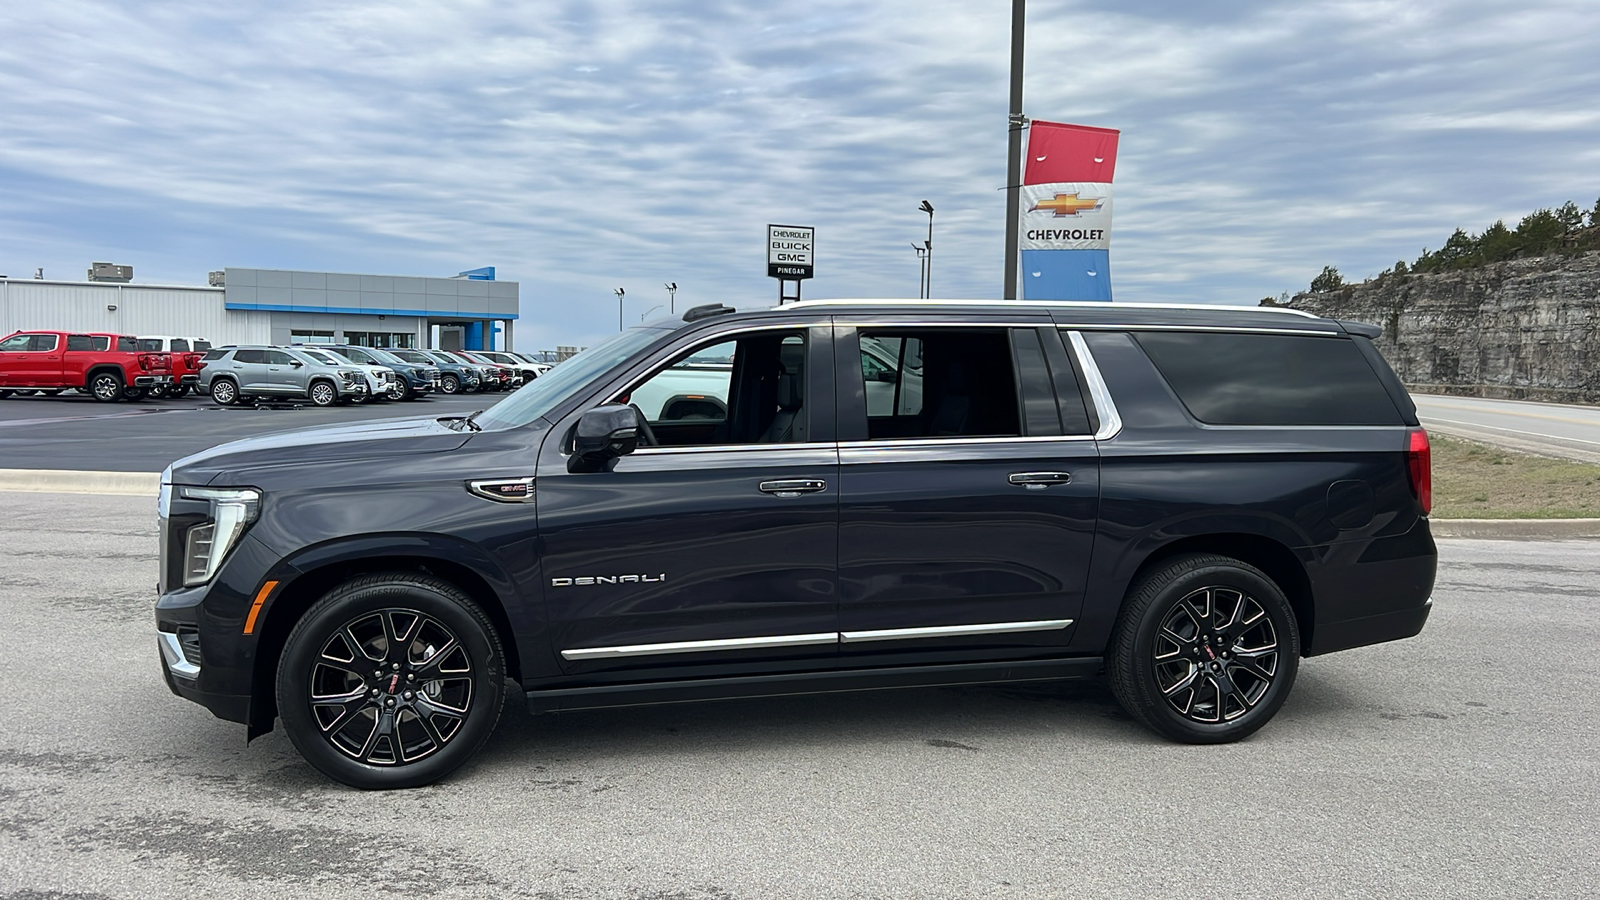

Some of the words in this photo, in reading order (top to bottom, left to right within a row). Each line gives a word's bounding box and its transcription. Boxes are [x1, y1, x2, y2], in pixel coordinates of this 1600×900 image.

[773, 230, 811, 239] CHEVROLET
[1027, 229, 1104, 240] CHEVROLET
[772, 241, 811, 251] BUICK
[777, 253, 806, 262] GMC
[777, 266, 805, 275] PINEGAR
[500, 484, 526, 492] GMC
[551, 573, 665, 587] DENALI
